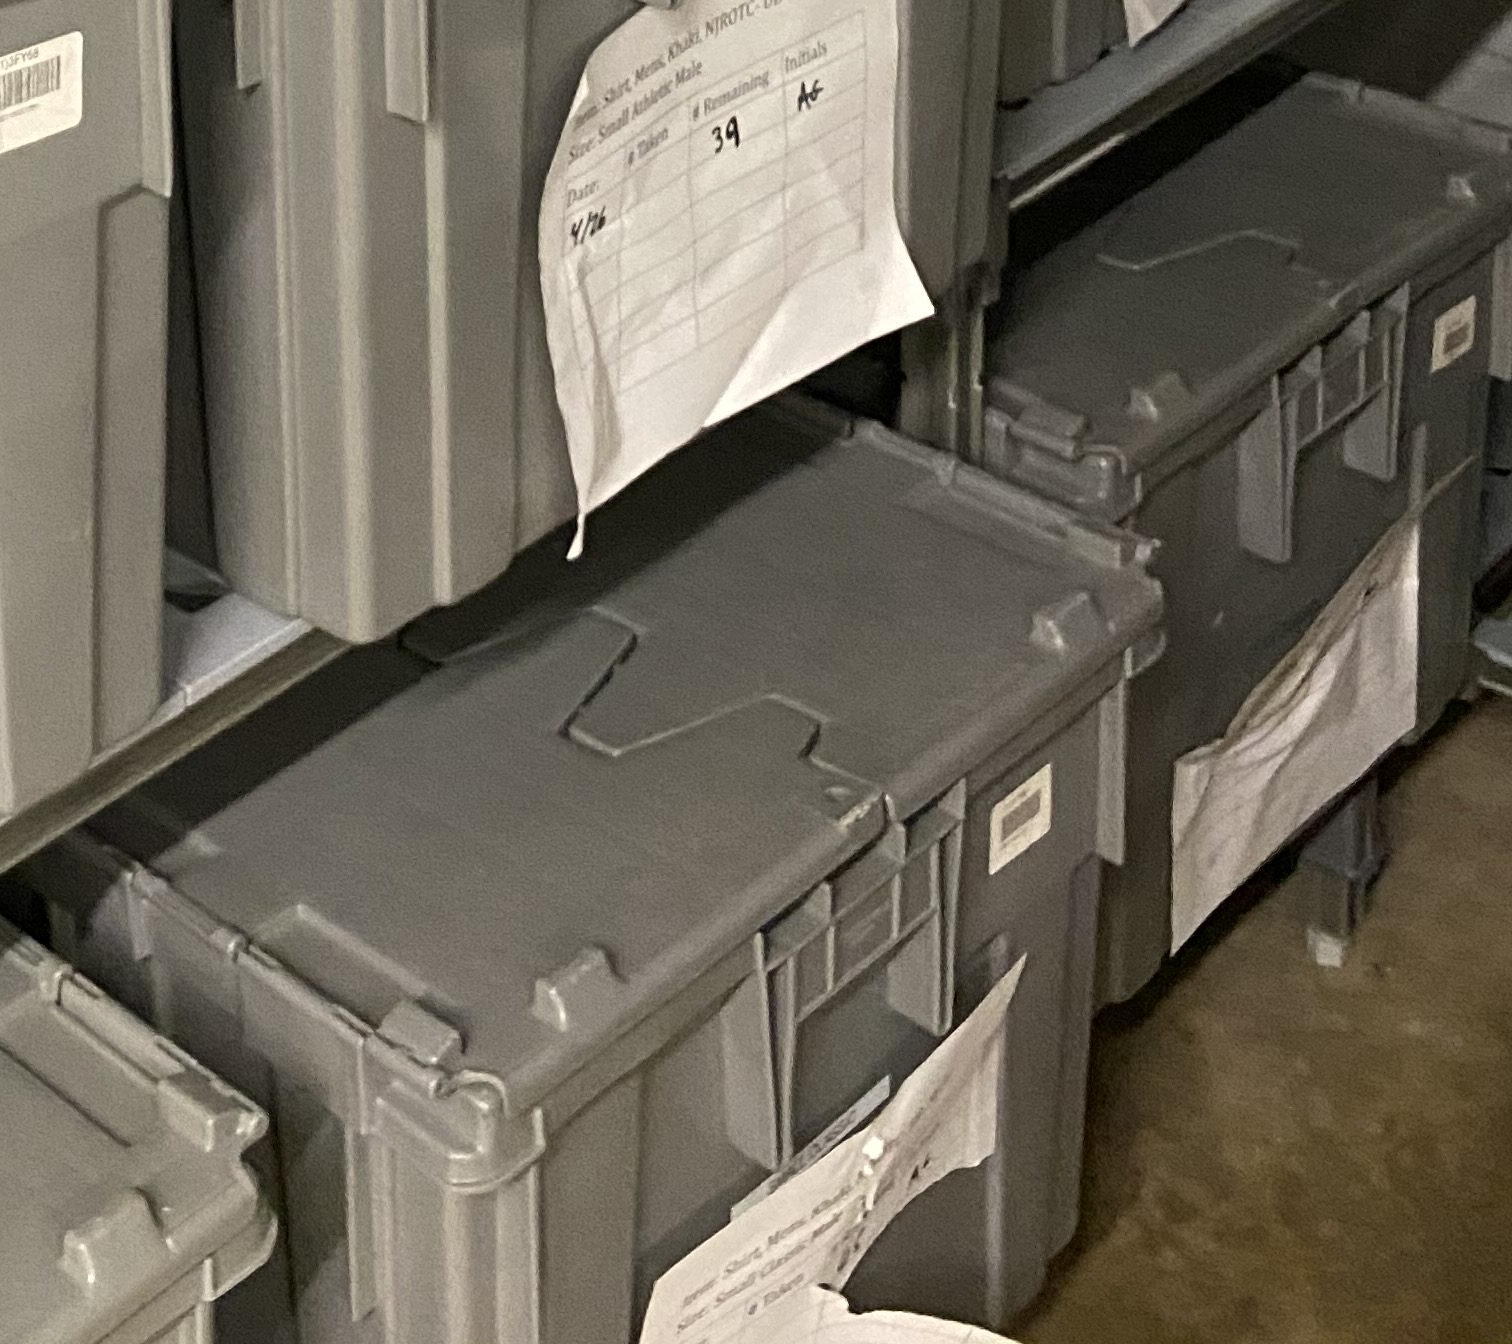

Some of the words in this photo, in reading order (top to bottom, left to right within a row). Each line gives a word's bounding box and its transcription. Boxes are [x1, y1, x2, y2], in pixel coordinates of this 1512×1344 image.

[705, 0, 761, 37] NJROTC-
[785, 41, 828, 74] Initials
[599, 107, 629, 143] Small
[675, 60, 703, 87] Male
[703, 70, 770, 116] Remaining
[638, 127, 668, 158] Taken
[712, 115, 740, 154] 39
[567, 180, 599, 207] Date:
